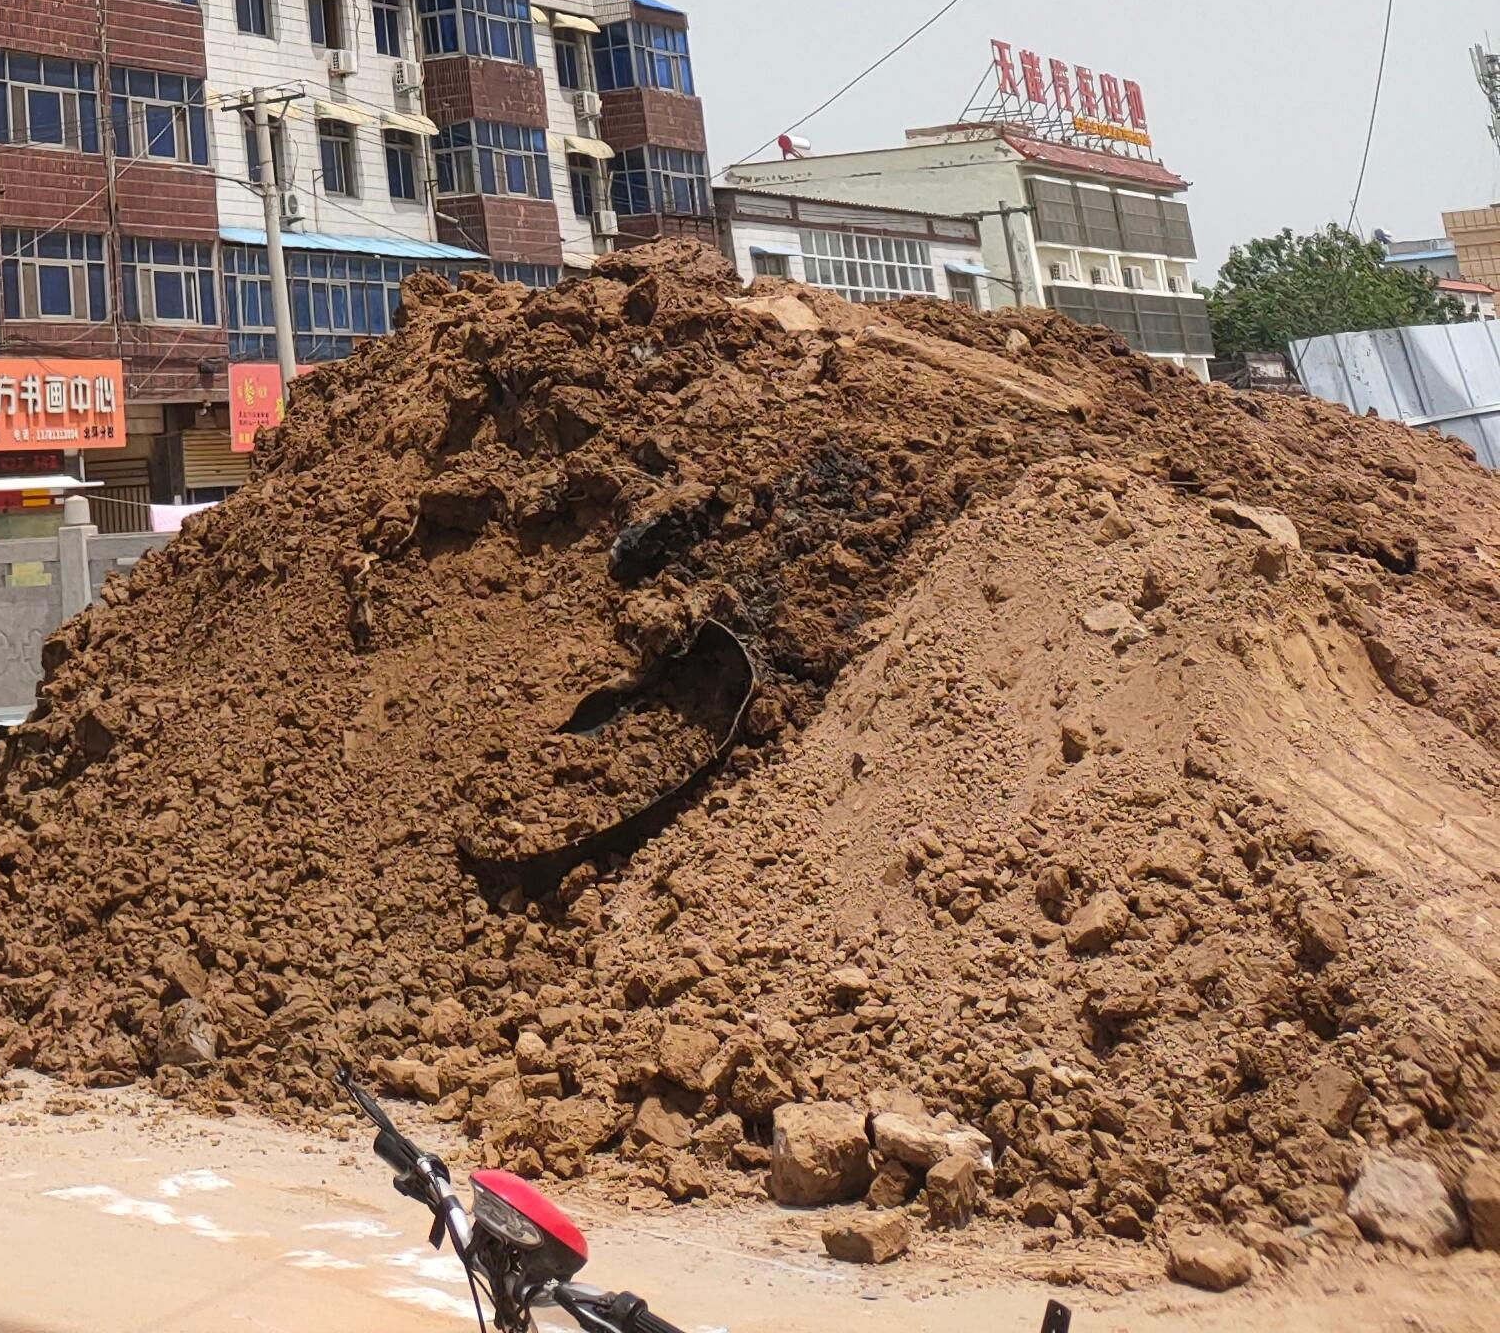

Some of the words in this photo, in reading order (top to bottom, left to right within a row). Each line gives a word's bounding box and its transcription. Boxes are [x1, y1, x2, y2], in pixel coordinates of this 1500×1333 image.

[990, 38, 1149, 130] 天能汽车电池
